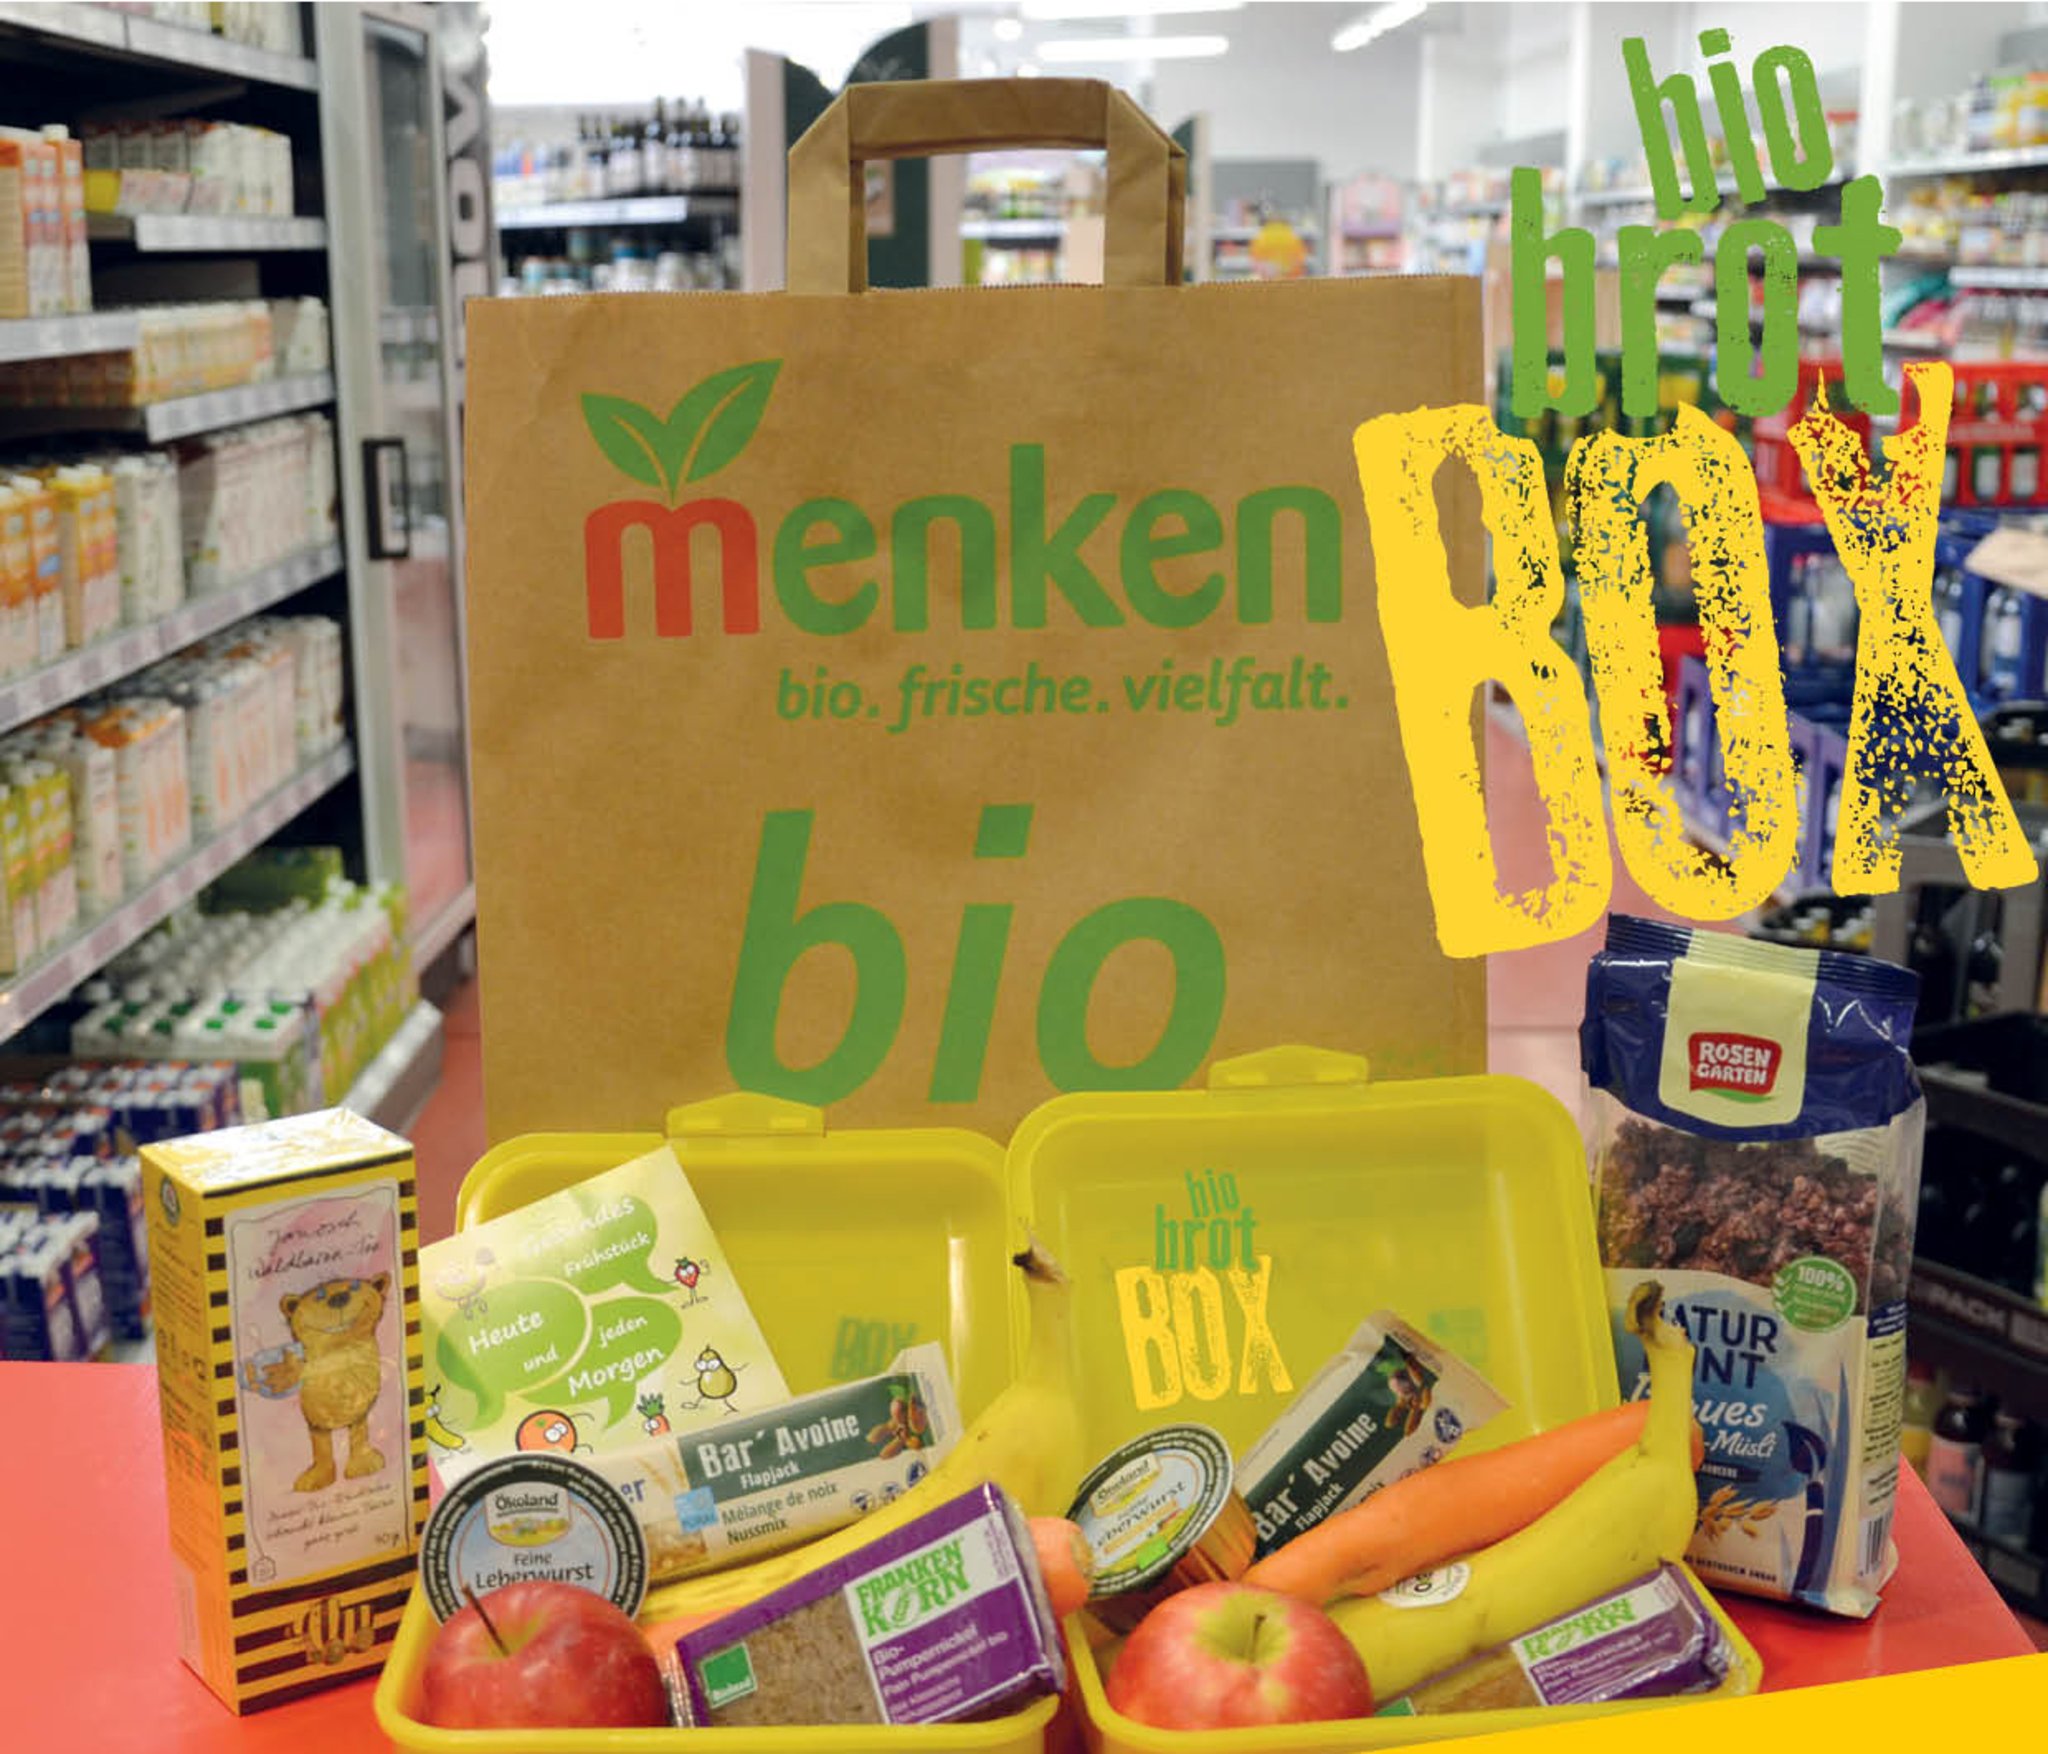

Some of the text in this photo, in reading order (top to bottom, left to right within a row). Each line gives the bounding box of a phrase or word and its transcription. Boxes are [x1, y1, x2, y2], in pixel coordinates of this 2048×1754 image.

[584, 443, 1343, 638] menken
[776, 656, 1350, 733] bio. frische. vielfalt.
[723, 804, 1228, 1108] bio
[1696, 1062, 1767, 1085] GARTEN
[1699, 1041, 1771, 1068] ROSEN
[1184, 1169, 1240, 1218] bio
[1155, 1203, 1258, 1272] brot
[1798, 1266, 1846, 1292] 100%
[468, 1311, 544, 1356] Heute
[599, 1315, 648, 1348] jeden
[1115, 1254, 1294, 1411] BOX
[523, 1343, 560, 1372] und
[567, 1347, 665, 1396] Morgen
[777, 1413, 861, 1458] Avoine
[1303, 1412, 1378, 1487] Avoine
[1703, 1429, 1778, 1458] -Müsli
[740, 1461, 801, 1489] Flapjack
[722, 1495, 783, 1526] Mélange
[786, 1490, 805, 1507] de
[807, 1481, 839, 1501] noix
[1295, 1481, 1345, 1530] Flapjack
[727, 1517, 788, 1545] Nussmix
[476, 1562, 595, 1589] Leberwurst
[514, 1552, 552, 1566] Feine
[856, 1539, 964, 1598] FRANKEN
[879, 1623, 978, 1680] Pumpernickel
